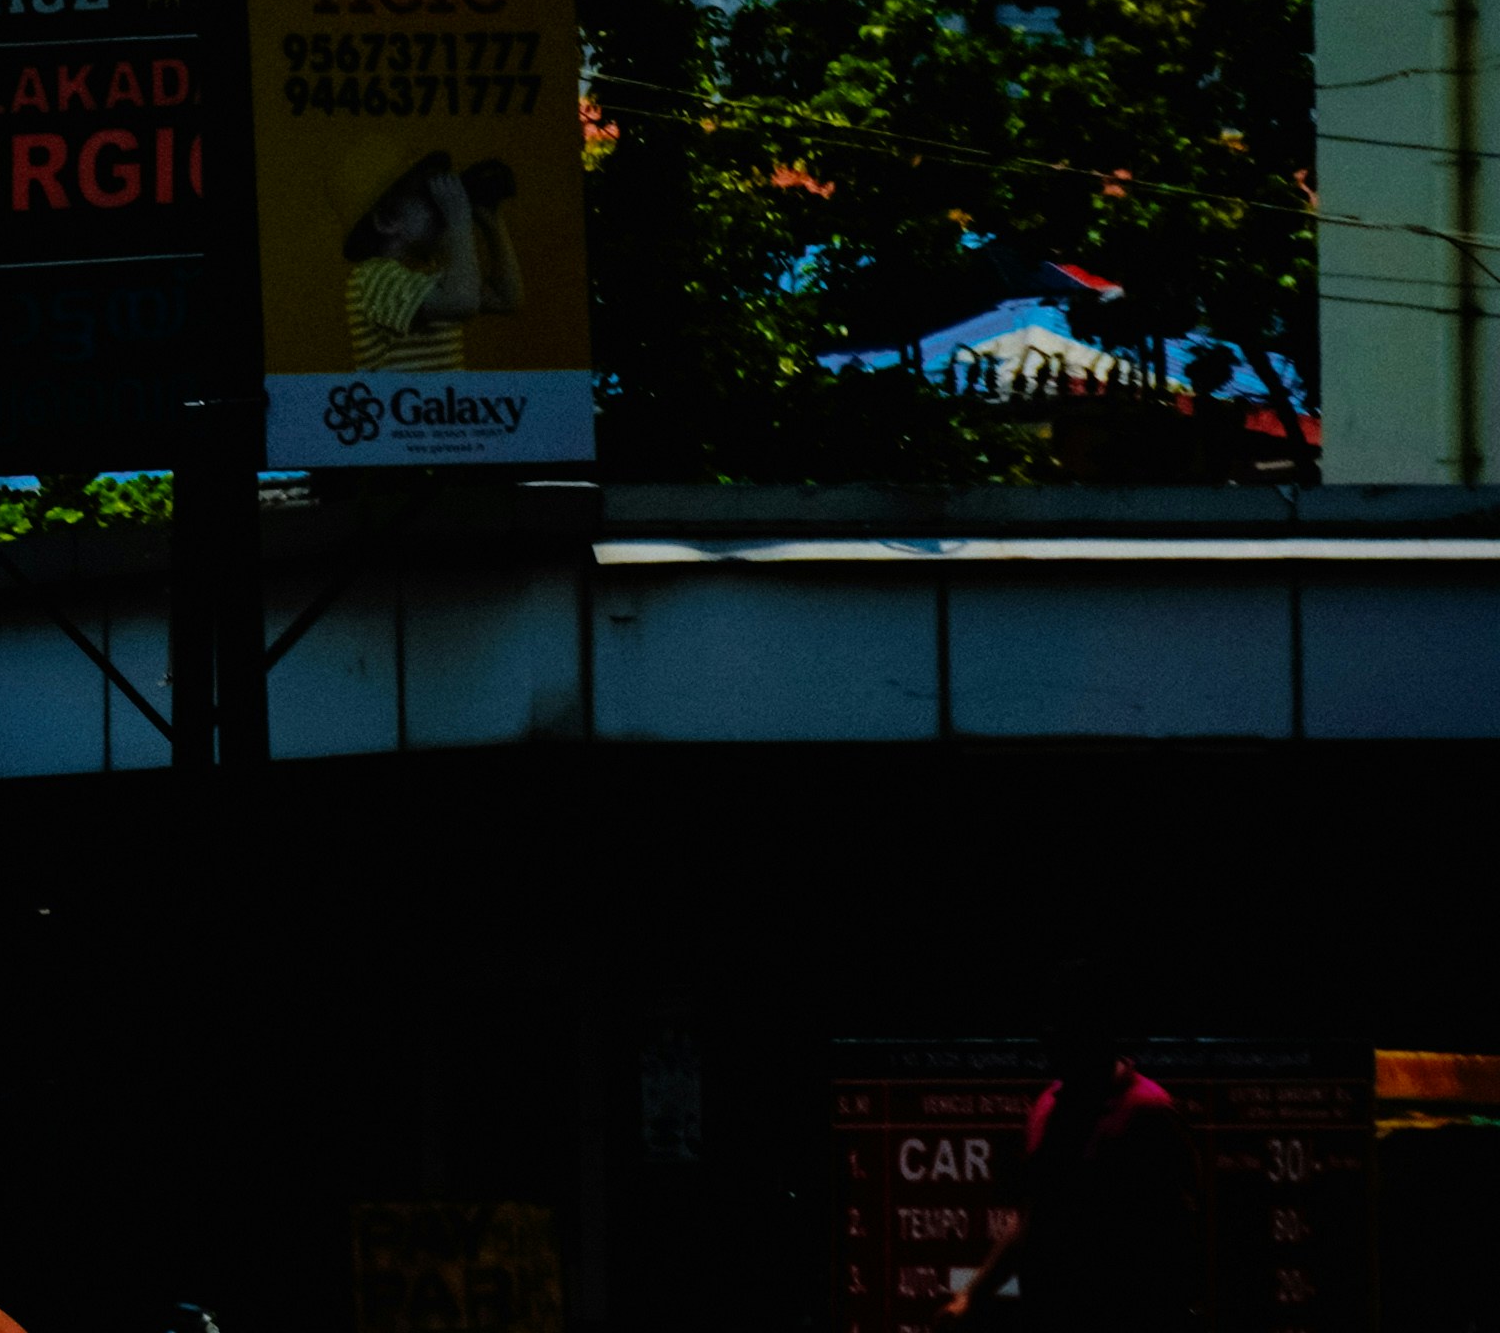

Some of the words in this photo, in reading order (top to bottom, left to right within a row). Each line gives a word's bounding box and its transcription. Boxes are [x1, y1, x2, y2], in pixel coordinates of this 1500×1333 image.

[284, 32, 540, 73] 9567371777
[284, 74, 542, 117] 9446371777
[390, 386, 528, 434] Galaxy
[897, 1137, 993, 1183] CAR
[896, 1205, 970, 1242] TEMPO
